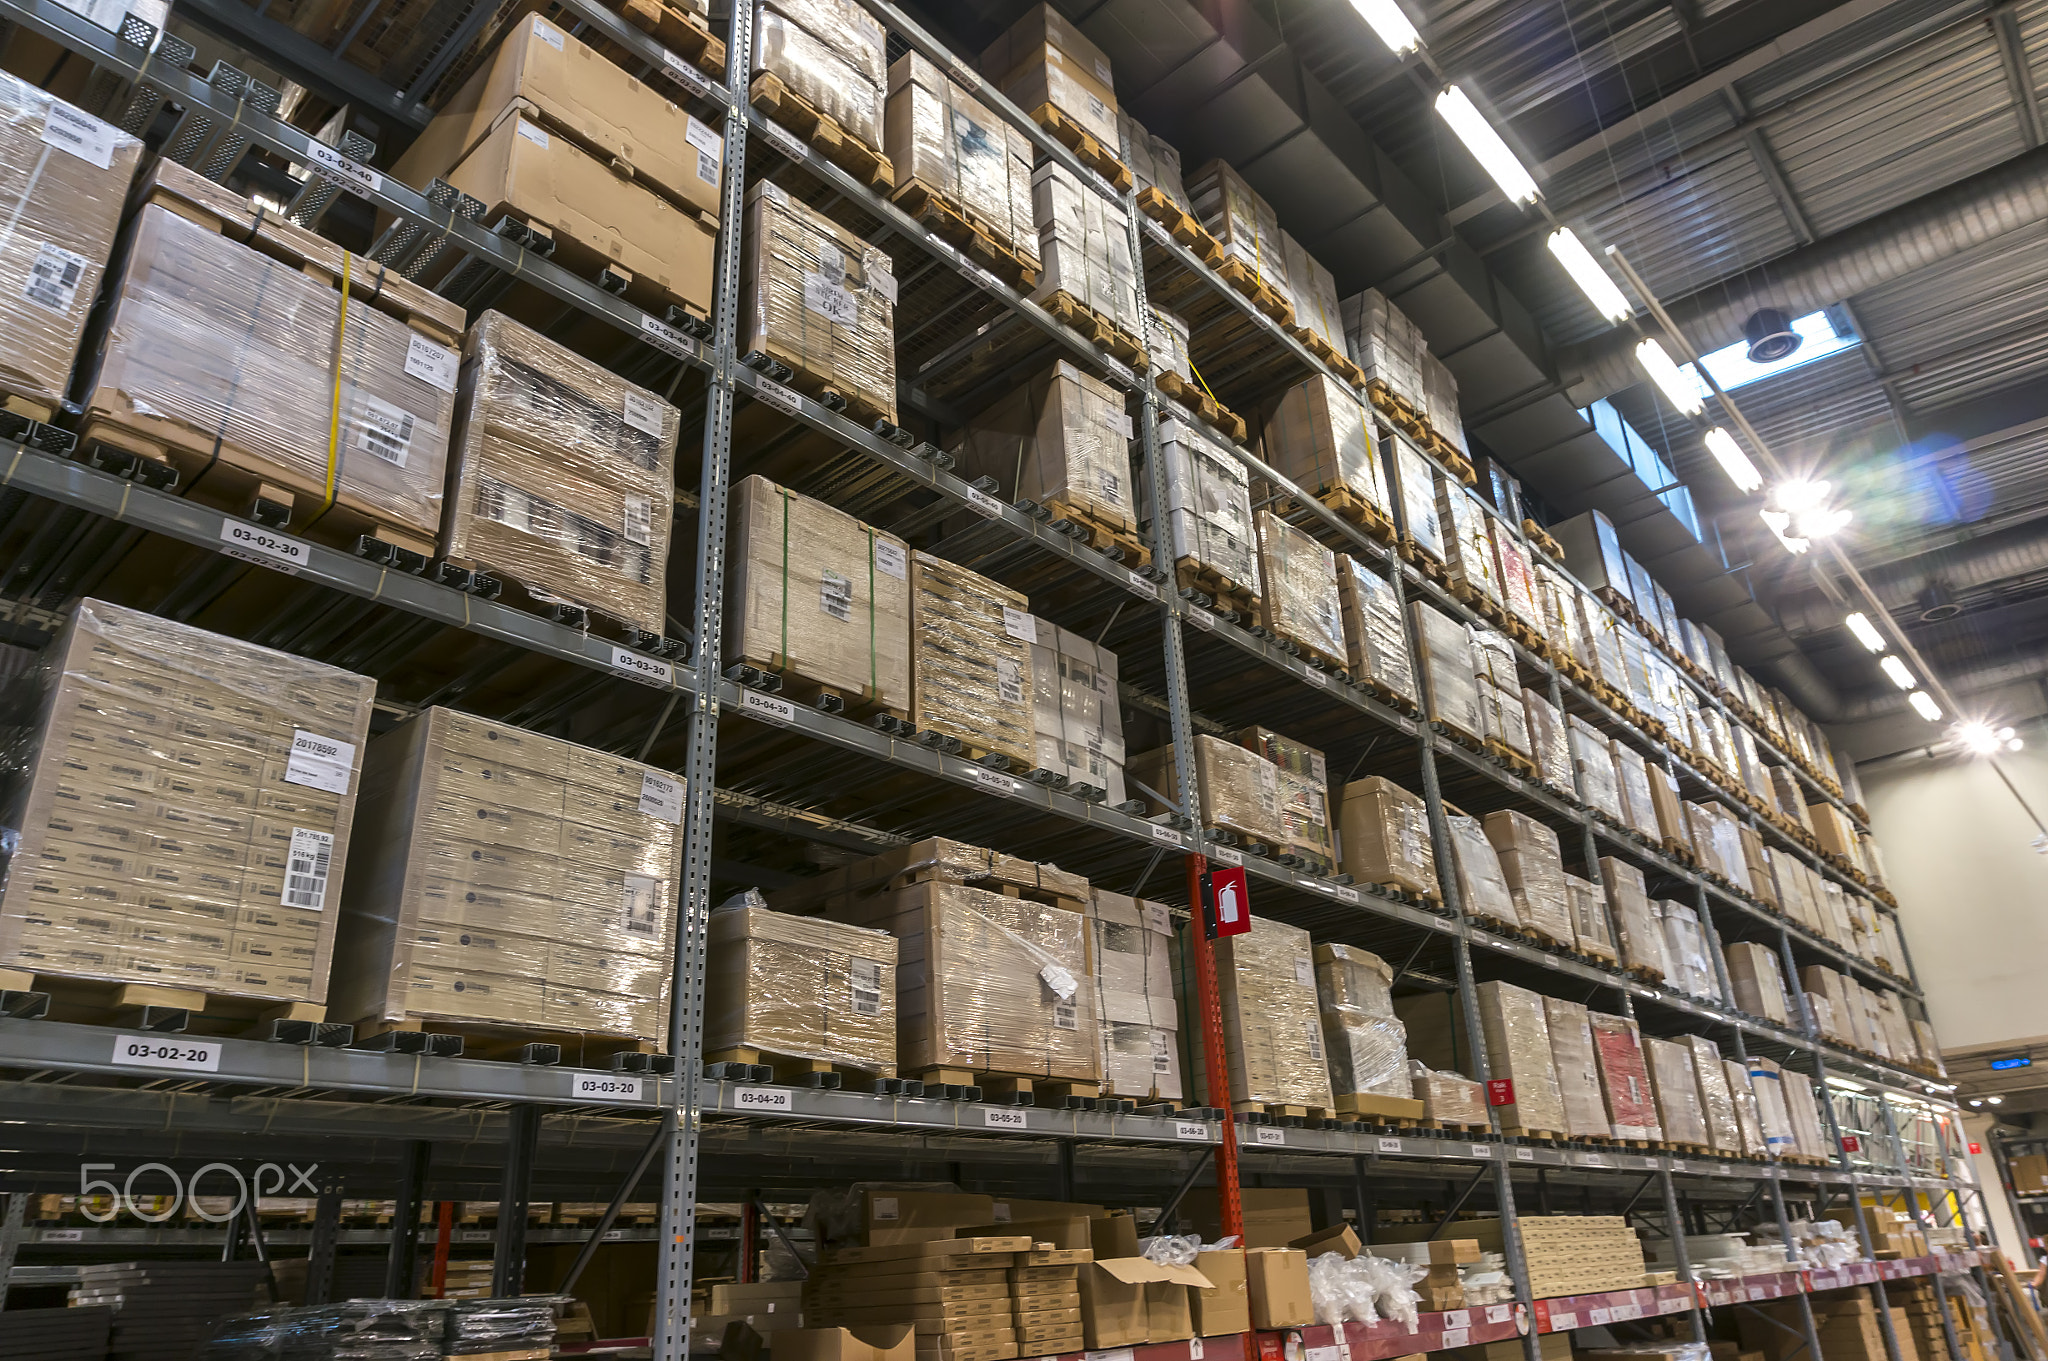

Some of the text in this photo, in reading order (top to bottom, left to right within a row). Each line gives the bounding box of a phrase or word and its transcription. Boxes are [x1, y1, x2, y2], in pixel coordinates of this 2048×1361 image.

[668, 71, 701, 95] 03-03-50
[317, 149, 372, 182] 03-02-40
[314, 166, 364, 195] 03-02-40
[648, 321, 689, 346] 03-03-40
[762, 381, 798, 404] 03-04-40
[233, 528, 299, 556] 03-02-30
[229, 550, 290, 572] 03-02-30
[620, 655, 665, 675] 03-03-30
[749, 696, 788, 715] 03-04-30
[295, 738, 337, 756] 20178592
[981, 773, 1011, 787] 03-05-30
[128, 1044, 208, 1062] 03-02-20
[582, 1081, 634, 1093] 03-03-20
[742, 1093, 785, 1104] 03-04-20
[990, 1113, 1022, 1124] 03-05-20
